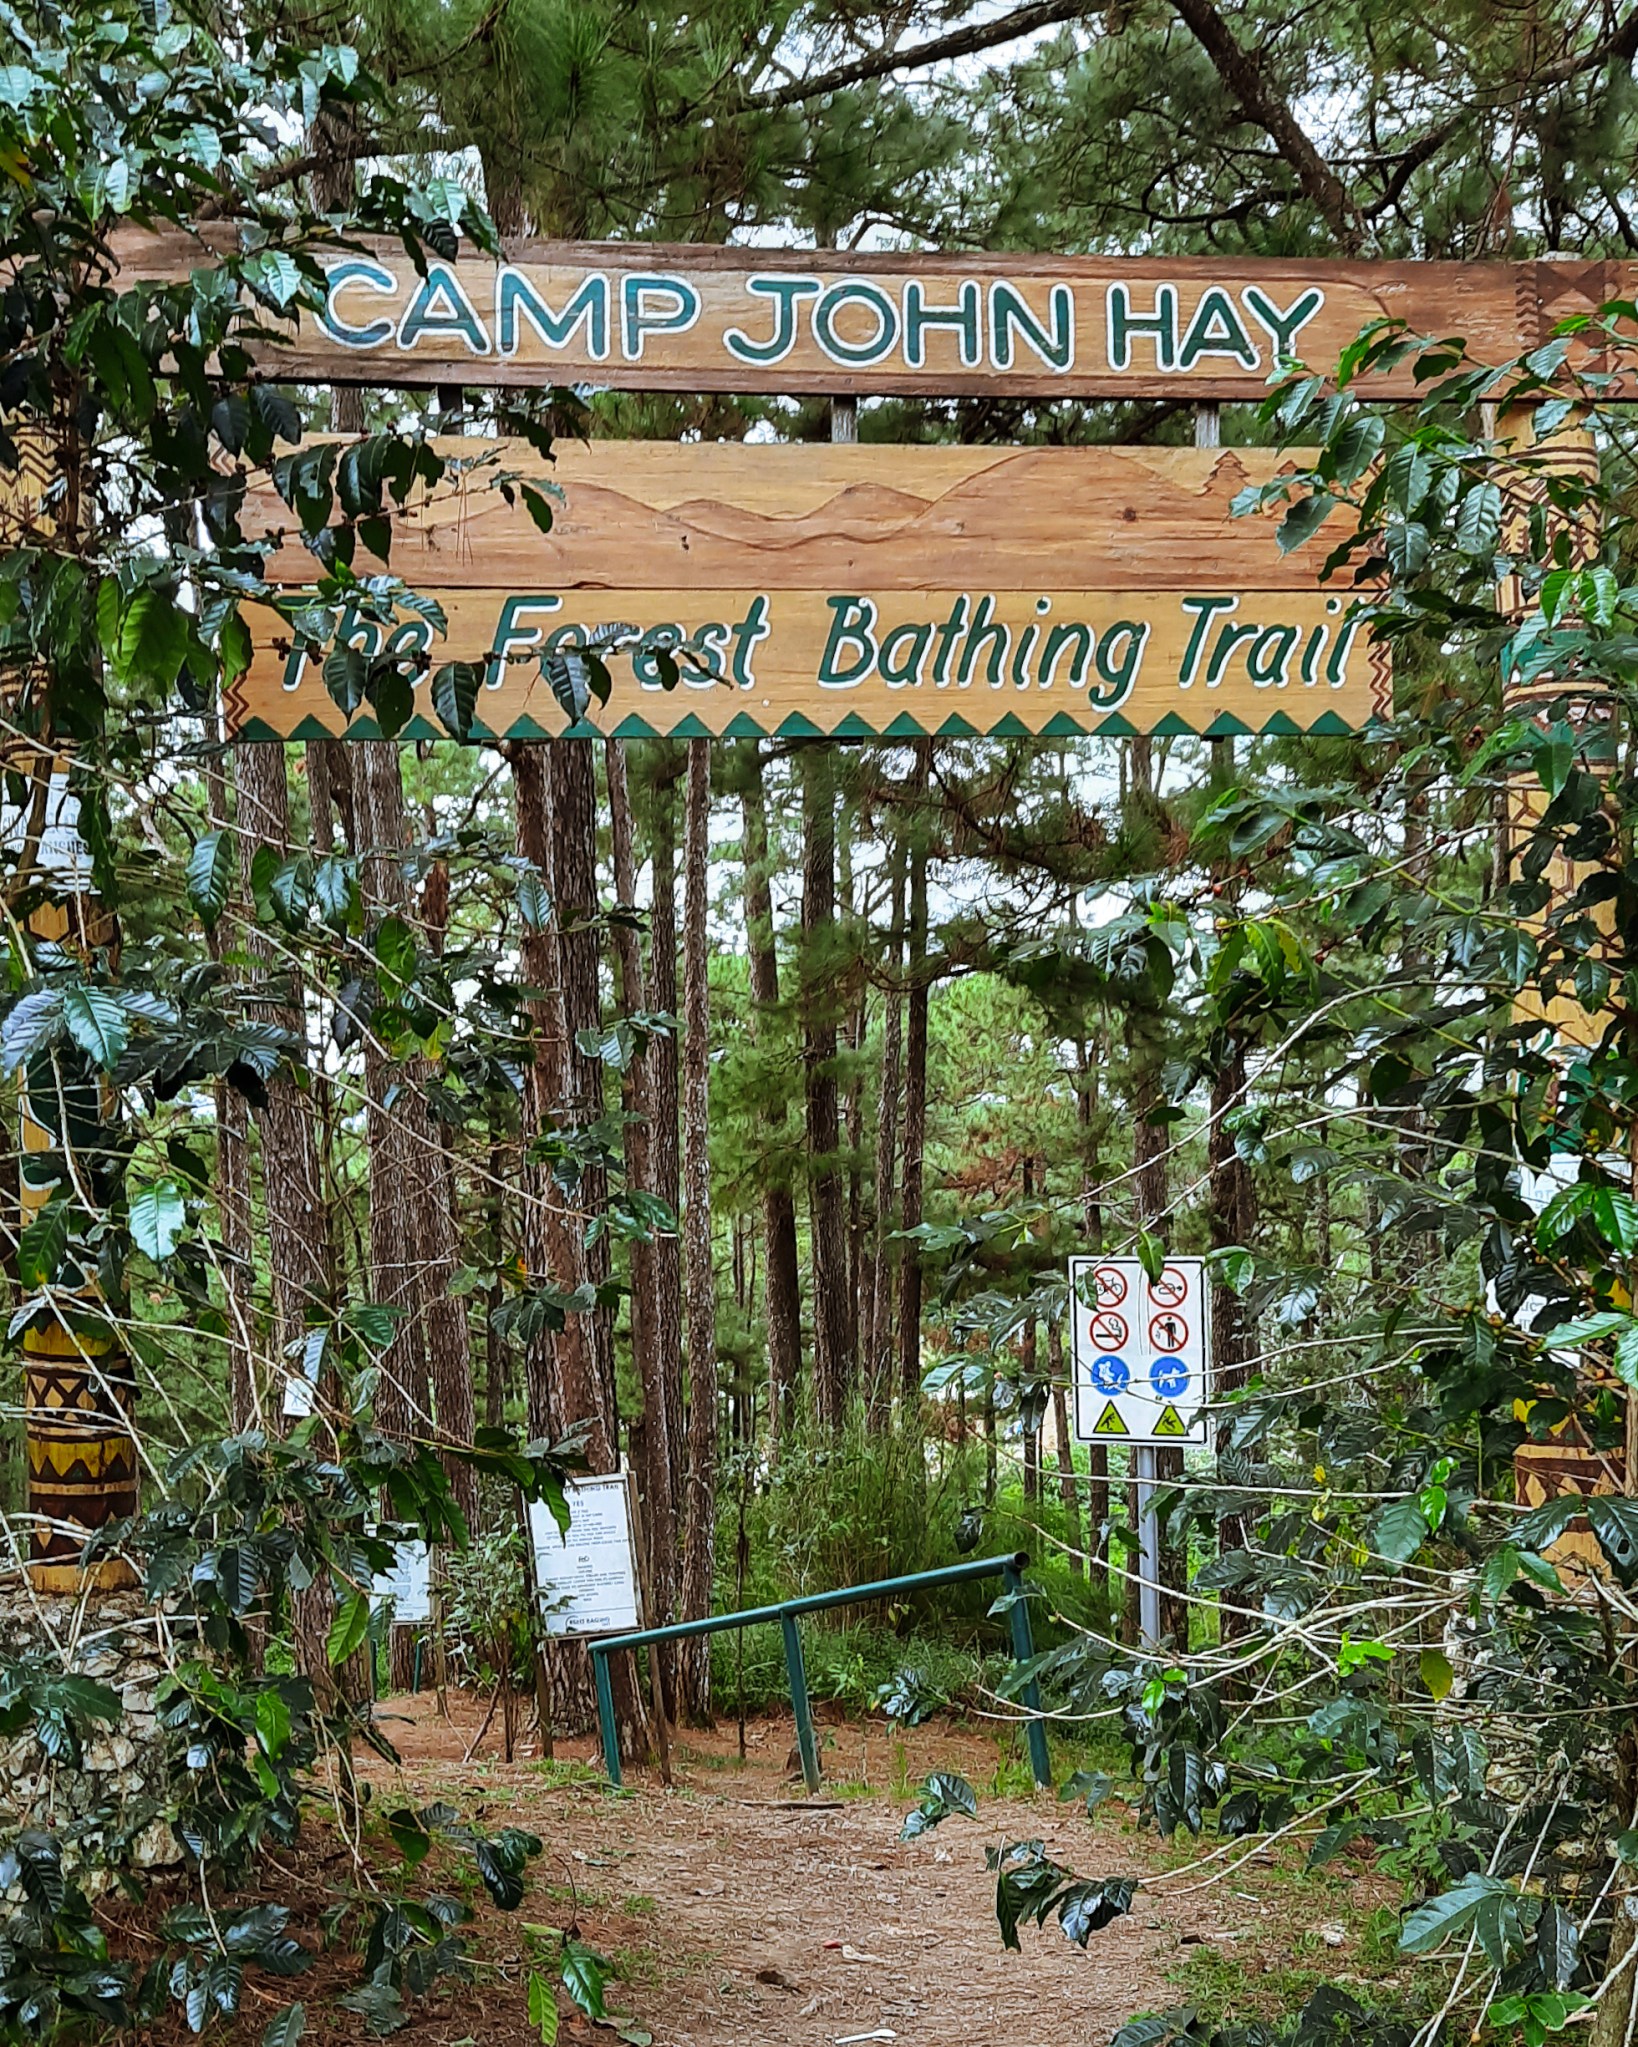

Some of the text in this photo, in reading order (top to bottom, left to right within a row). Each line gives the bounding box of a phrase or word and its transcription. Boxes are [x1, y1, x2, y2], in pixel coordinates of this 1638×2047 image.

[314, 262, 1325, 374] CAMP JOHN HAY
[485, 594, 772, 692] Foest
[817, 593, 1151, 712] Bathing
[1178, 595, 1366, 689] Trail
